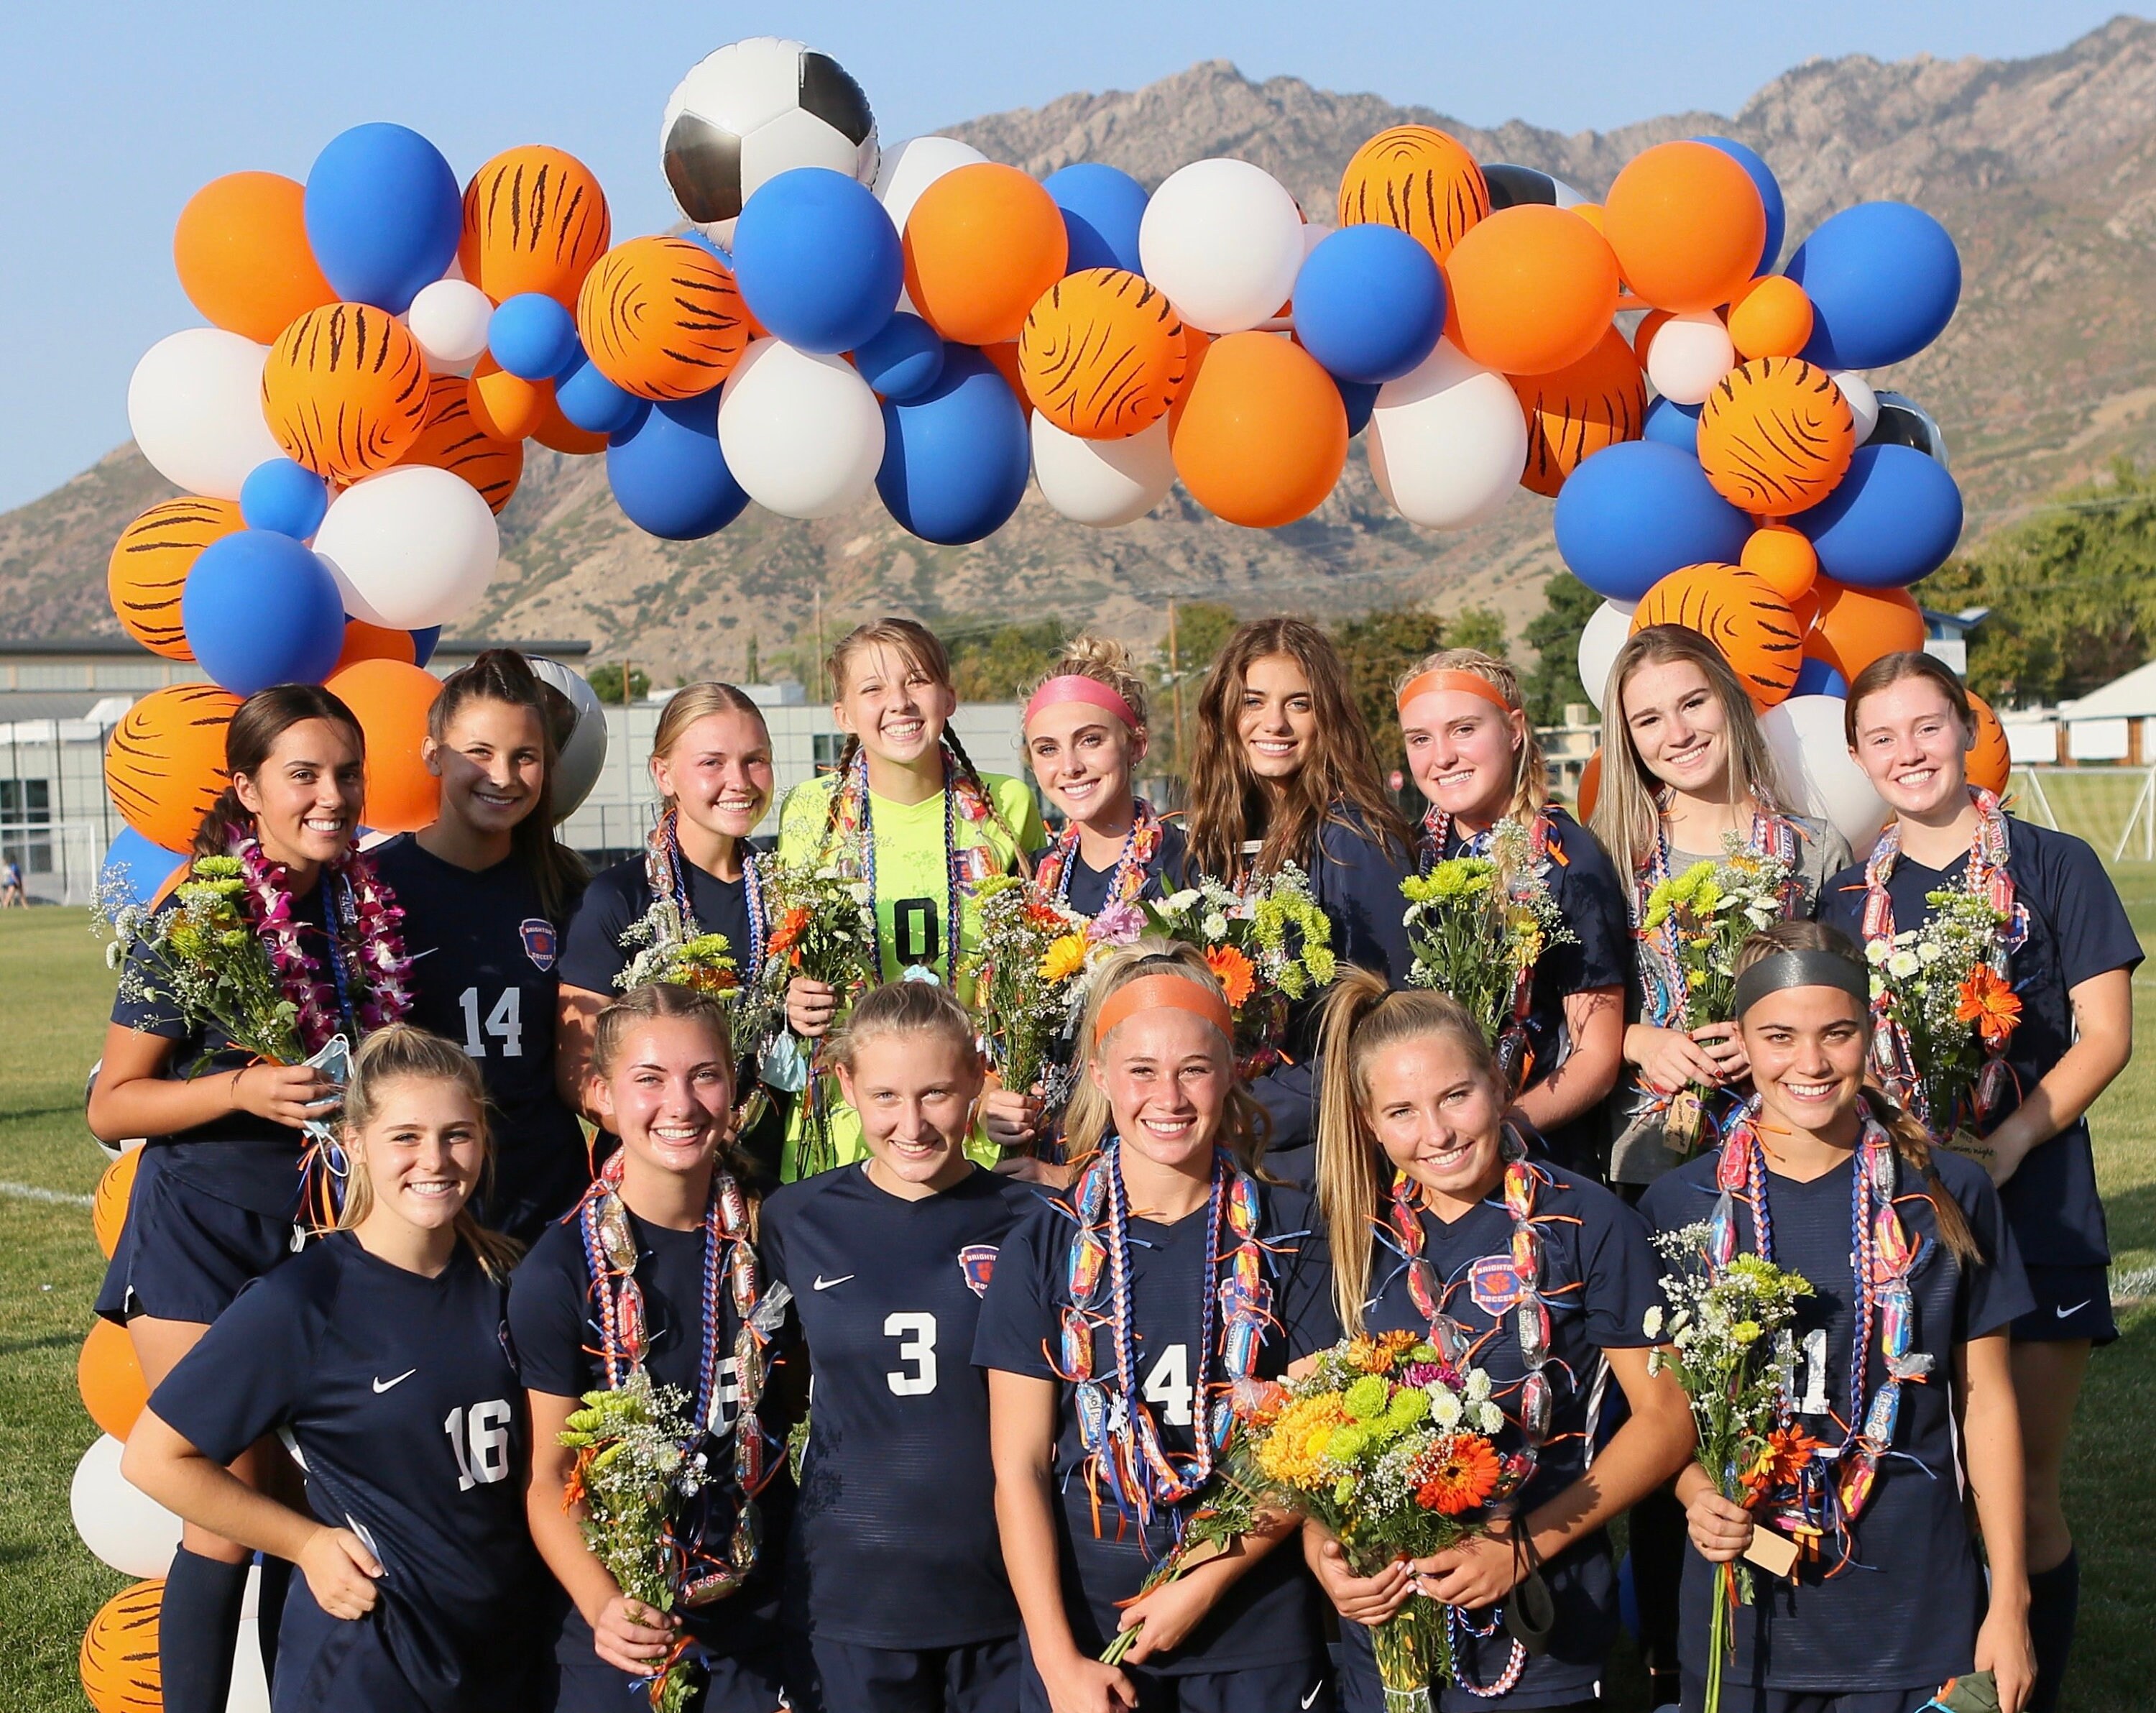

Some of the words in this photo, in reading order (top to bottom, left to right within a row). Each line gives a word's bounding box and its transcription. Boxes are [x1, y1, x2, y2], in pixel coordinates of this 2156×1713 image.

[532, 952, 553, 960] SOCCER
[894, 897, 939, 966] 0
[459, 987, 522, 1057] 14
[1477, 1264, 1513, 1274] BRIGHTO
[883, 1312, 938, 1396] 3
[1143, 1344, 1192, 1425] 4
[444, 1399, 511, 1492] 16
